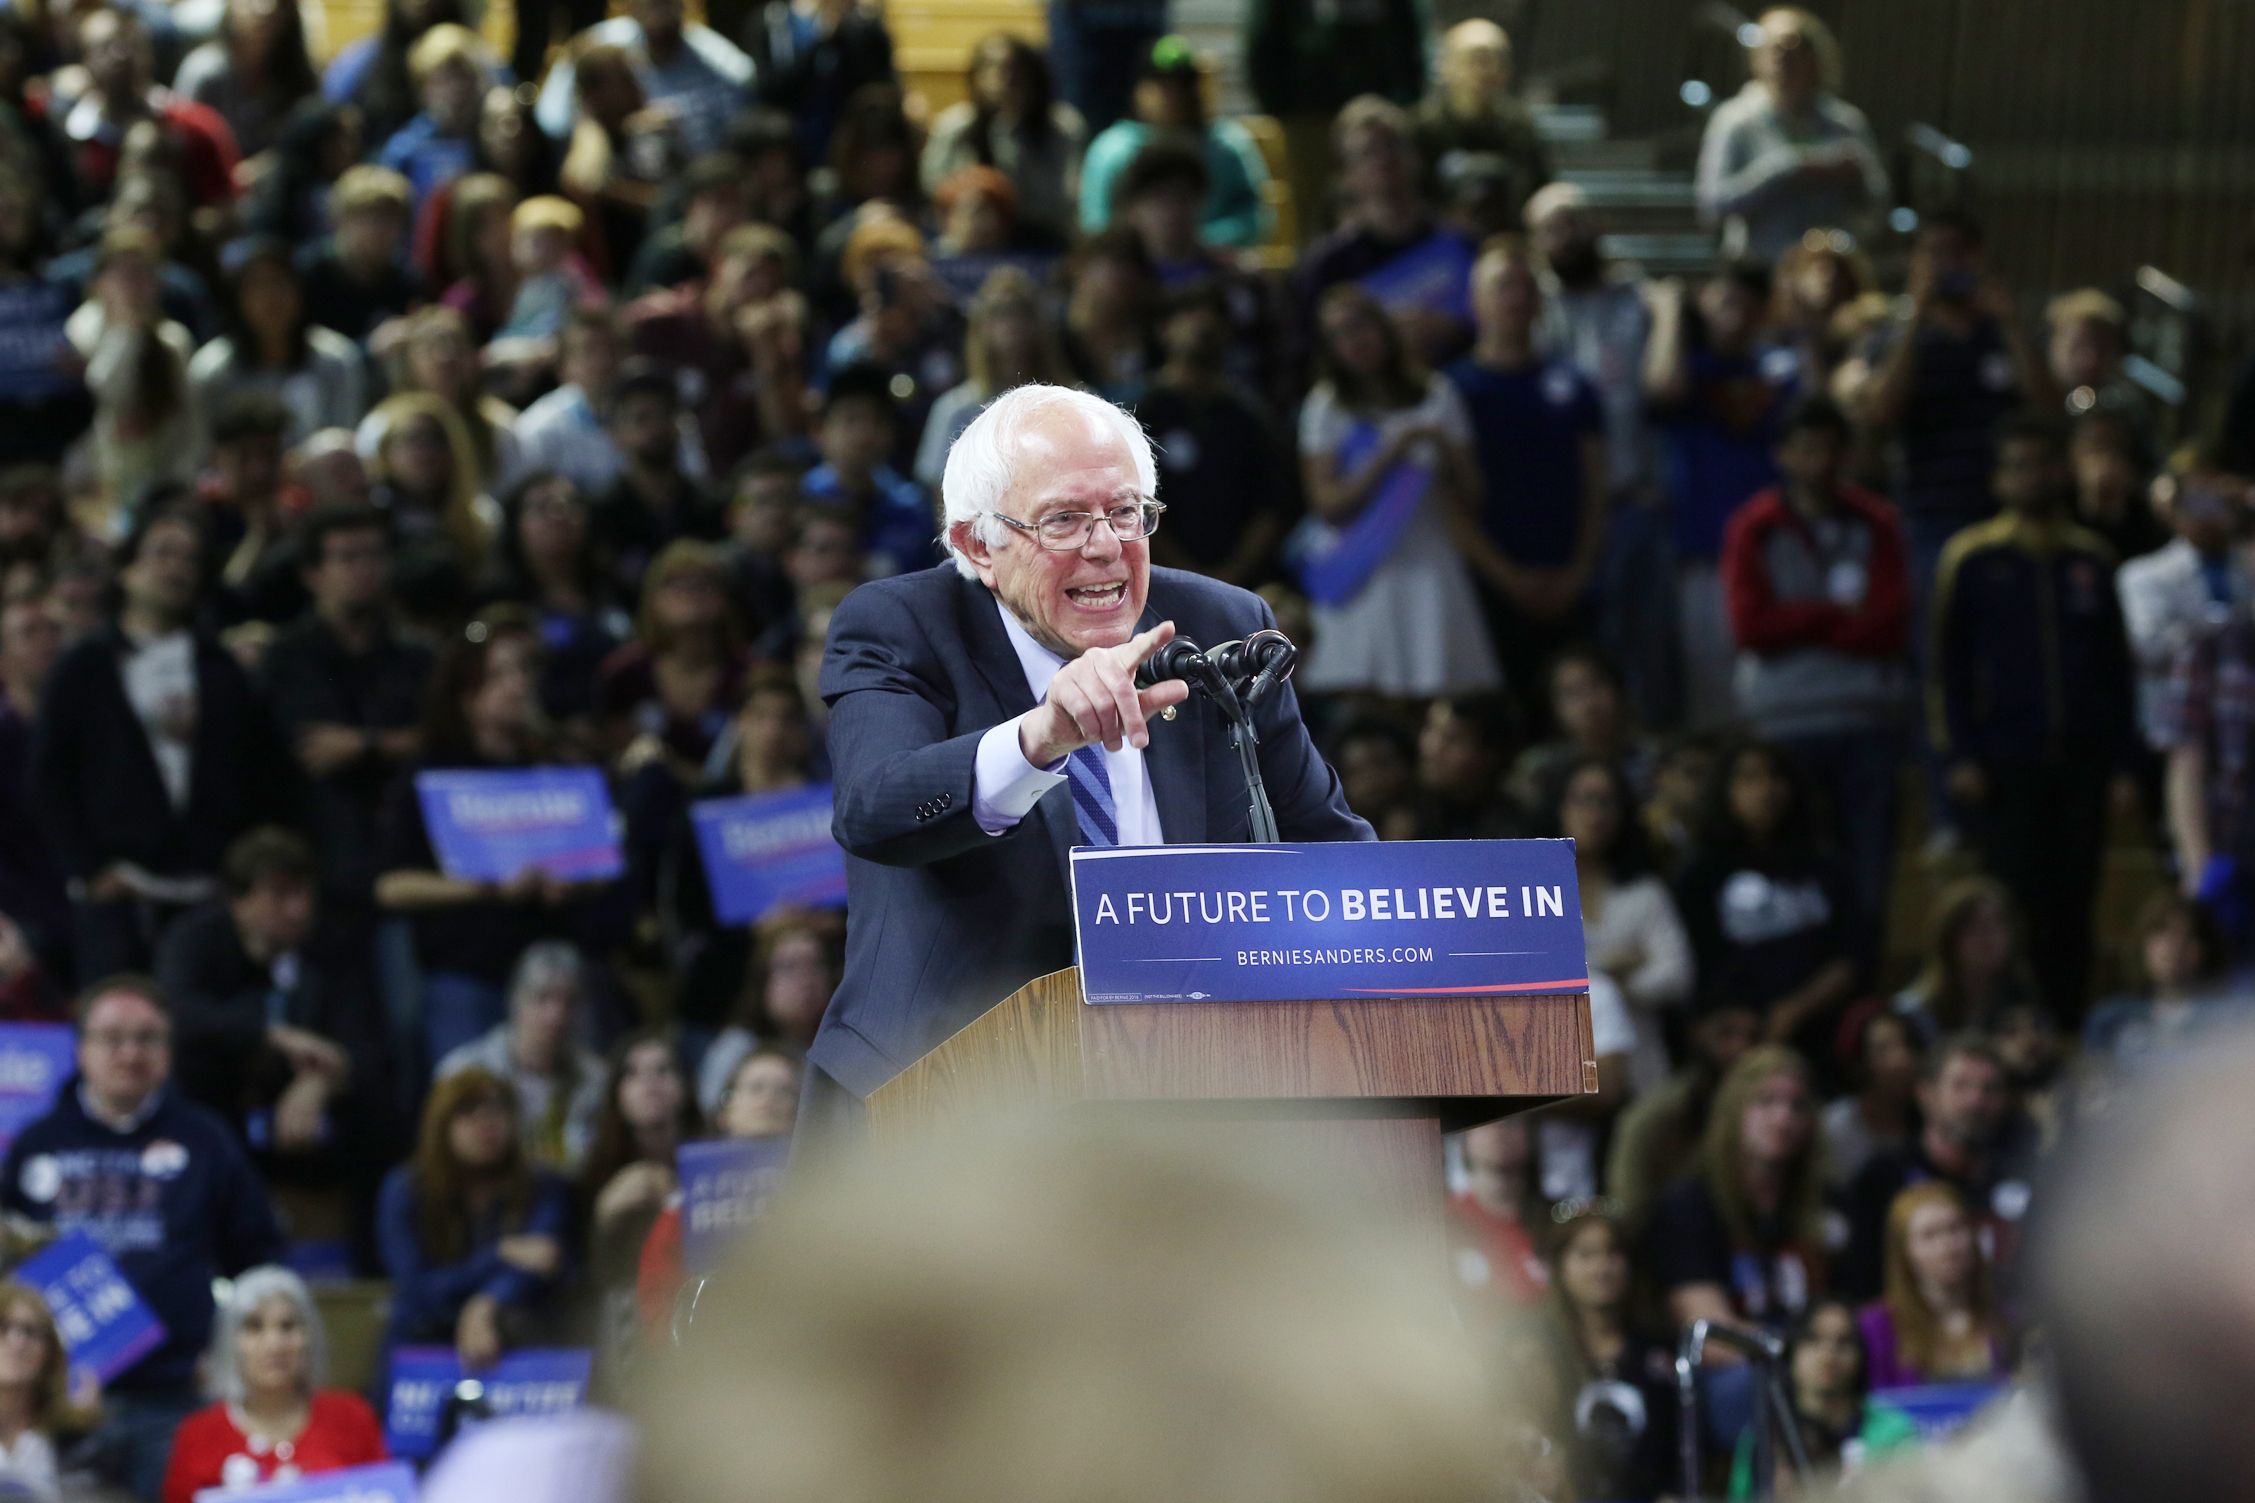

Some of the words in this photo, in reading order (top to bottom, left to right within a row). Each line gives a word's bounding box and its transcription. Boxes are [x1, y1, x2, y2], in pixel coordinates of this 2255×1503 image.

[1095, 893, 1120, 925] A
[1126, 890, 1271, 925] FUTURE
[1276, 889, 1330, 922] TO
[1340, 886, 1510, 921] BELIEVE
[1521, 885, 1564, 917] IN
[1237, 947, 1434, 966] BERNIESANDERS.COM
